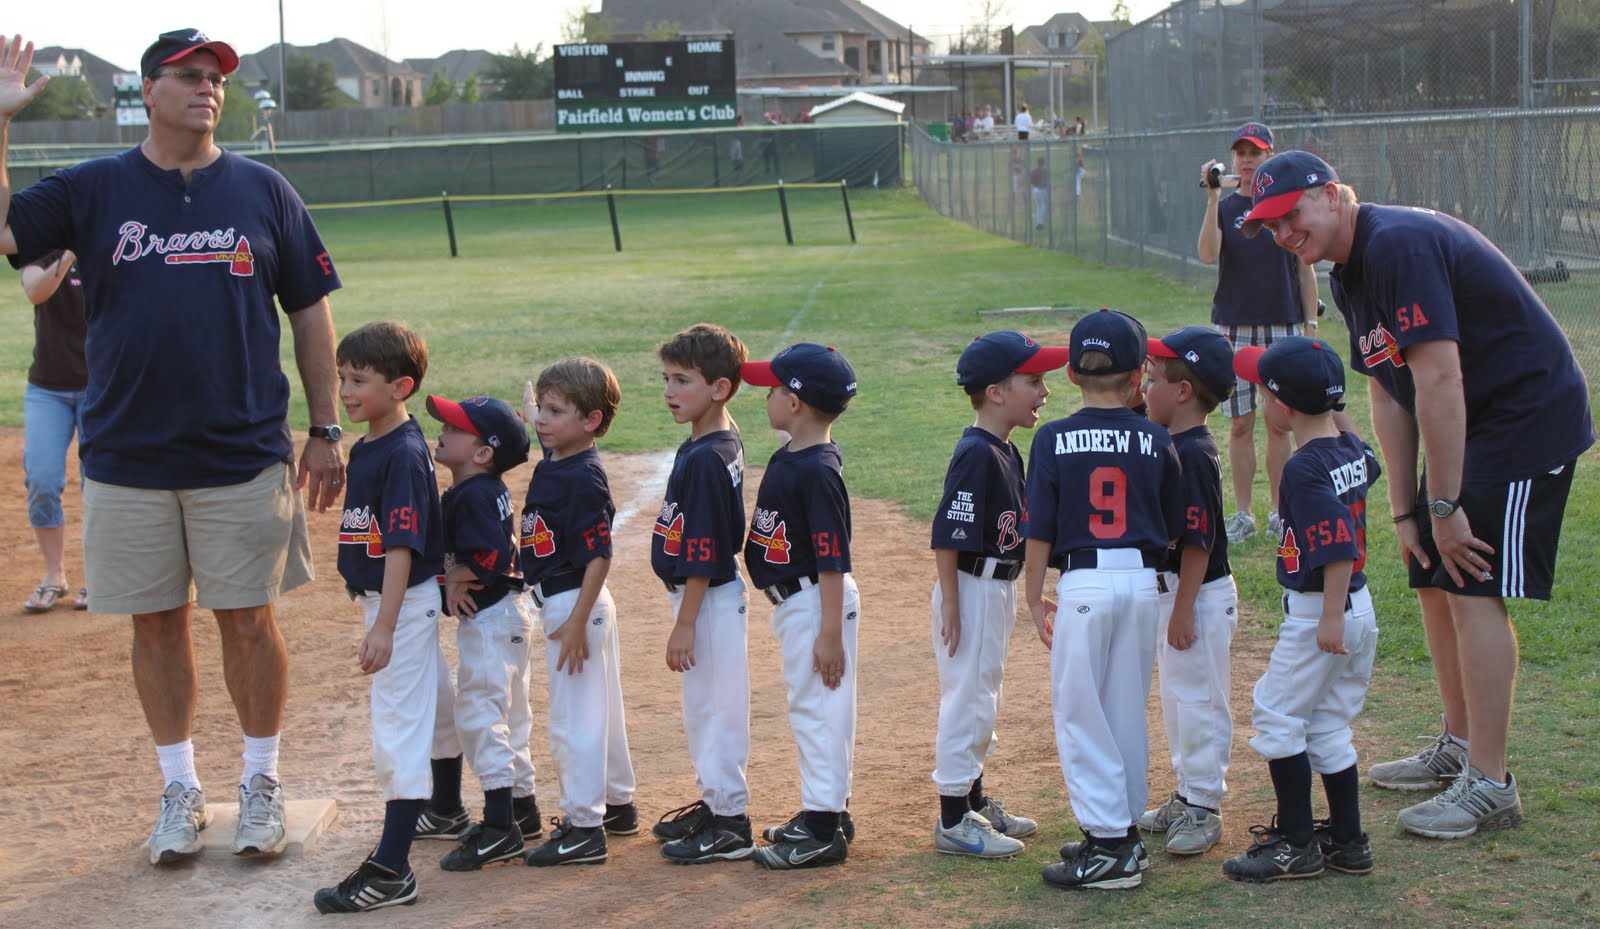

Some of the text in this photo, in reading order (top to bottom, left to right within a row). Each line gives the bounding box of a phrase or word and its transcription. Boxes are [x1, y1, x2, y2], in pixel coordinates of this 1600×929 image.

[558, 44, 608, 57] VISITOR
[686, 41, 723, 53] HOME
[624, 70, 666, 83] INNING
[557, 88, 584, 99] BALL
[618, 86, 656, 98] STRIKE
[687, 85, 710, 96] OUT
[557, 104, 736, 125] Fairfield Women's Club
[112, 220, 235, 266] Braves
[1055, 428, 1131, 455] ANDREW
[957, 490, 973, 502] THE
[1088, 466, 1128, 539] 9
[951, 500, 975, 513] SATIN
[946, 509, 976, 523] STITCH
[1304, 518, 1352, 552] FSA
